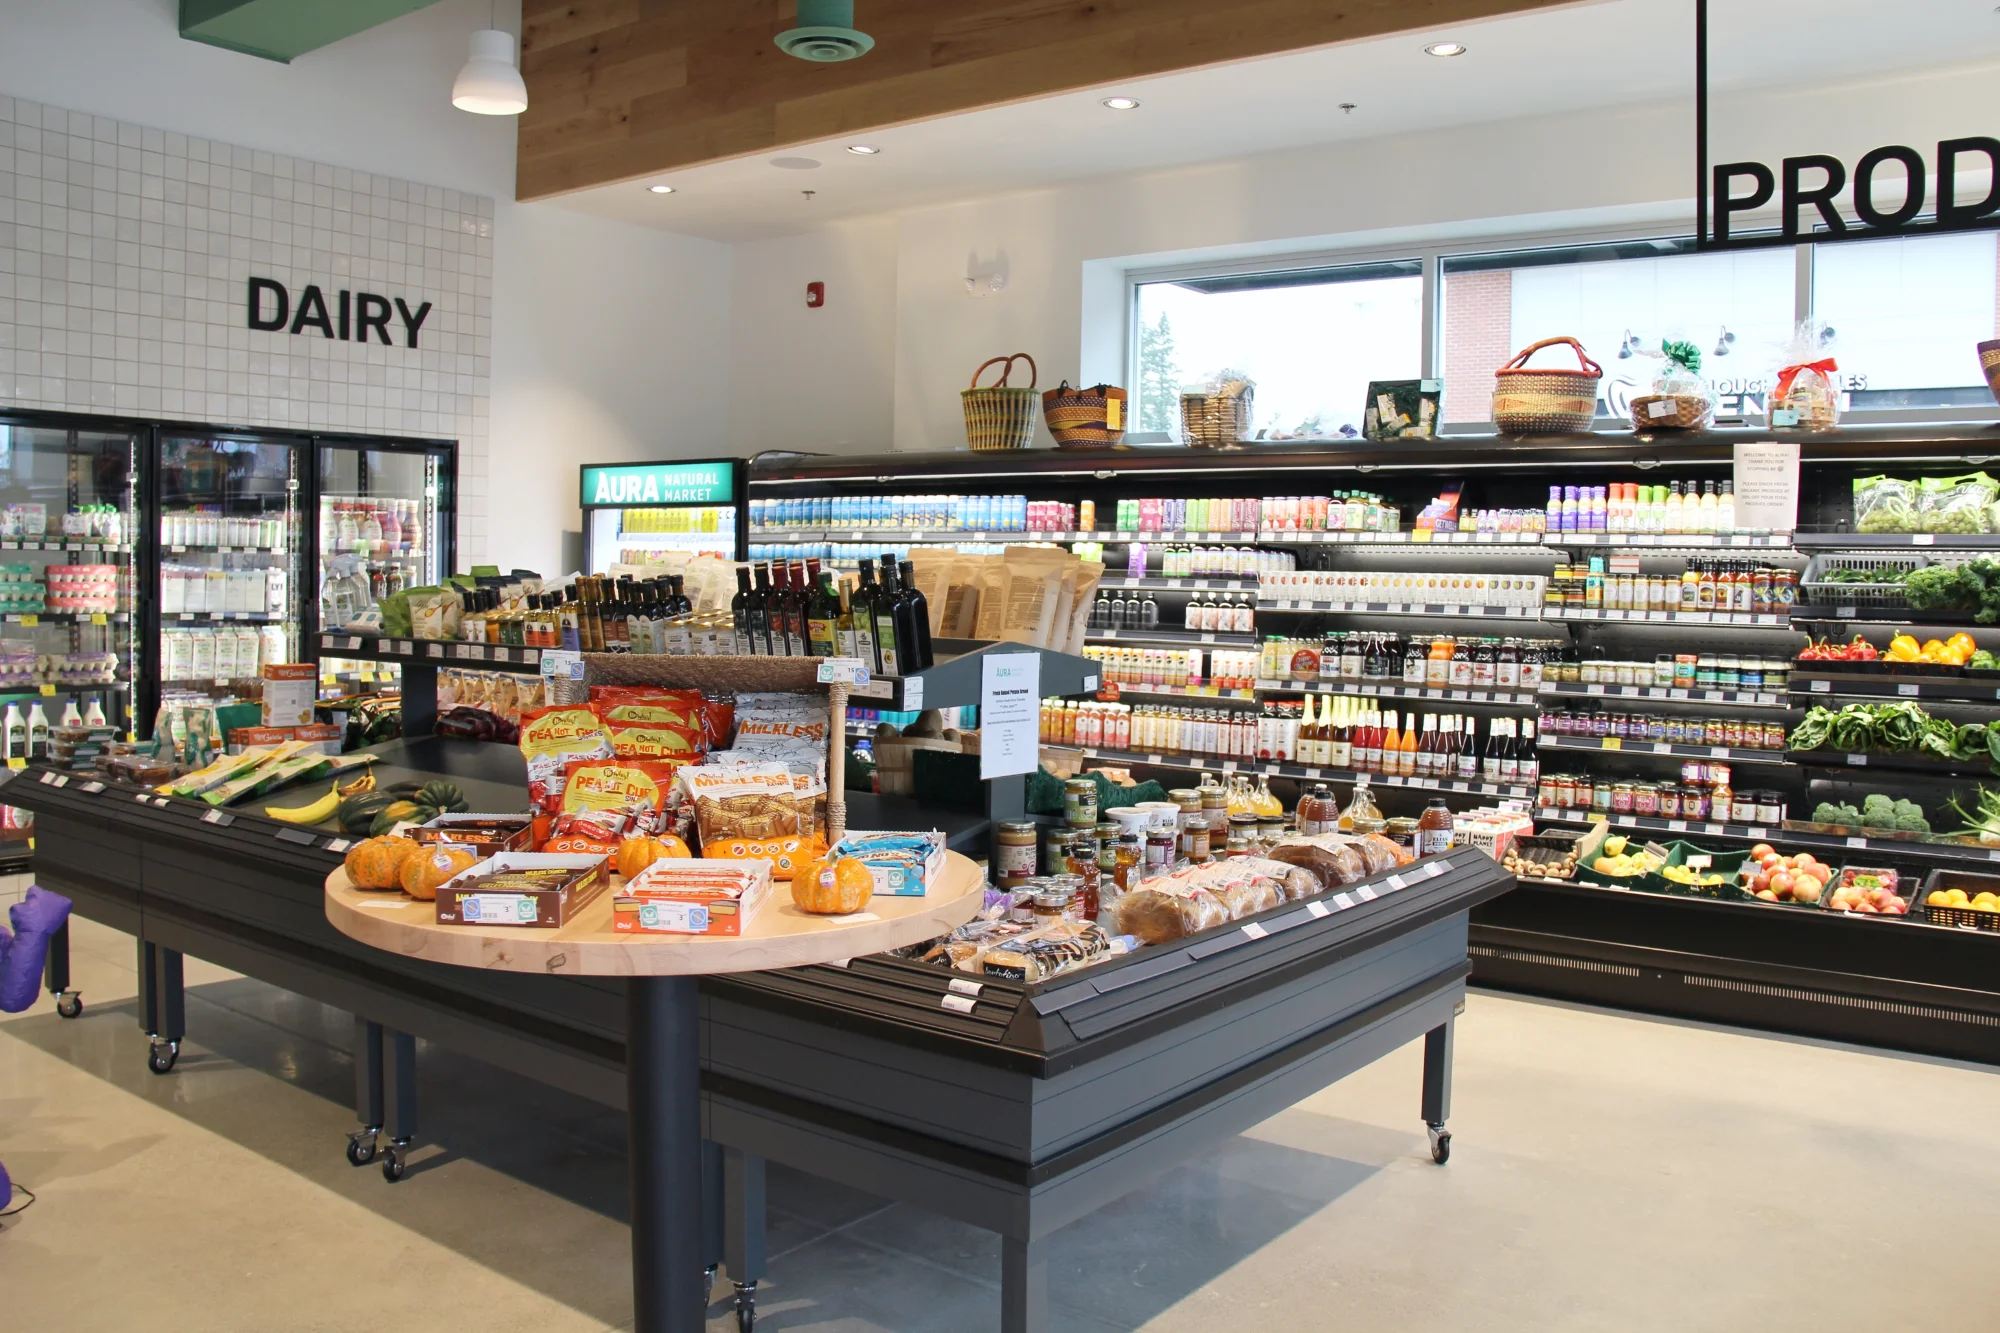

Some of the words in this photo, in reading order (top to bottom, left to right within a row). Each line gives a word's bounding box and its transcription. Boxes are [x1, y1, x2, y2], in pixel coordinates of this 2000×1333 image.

[247, 276, 433, 349] DAIRY
[594, 470, 660, 504] AURA
[664, 472, 720, 486] NATURAL
[664, 487, 713, 502] MARKET
[995, 667, 1011, 677] AURA
[528, 727, 555, 744] PEA
[554, 727, 571, 738] NOT
[739, 719, 824, 739] MILKLESS
[614, 743, 638, 756] PEA
[639, 745, 656, 753] NOT
[575, 776, 603, 792] PEA
[604, 780, 624, 792] NOT
[625, 783, 653, 797] CUP
[694, 773, 789, 788] MILKLESS
[426, 832, 491, 843] MKLESS
[1473, 833, 1494, 841] HAPPY
